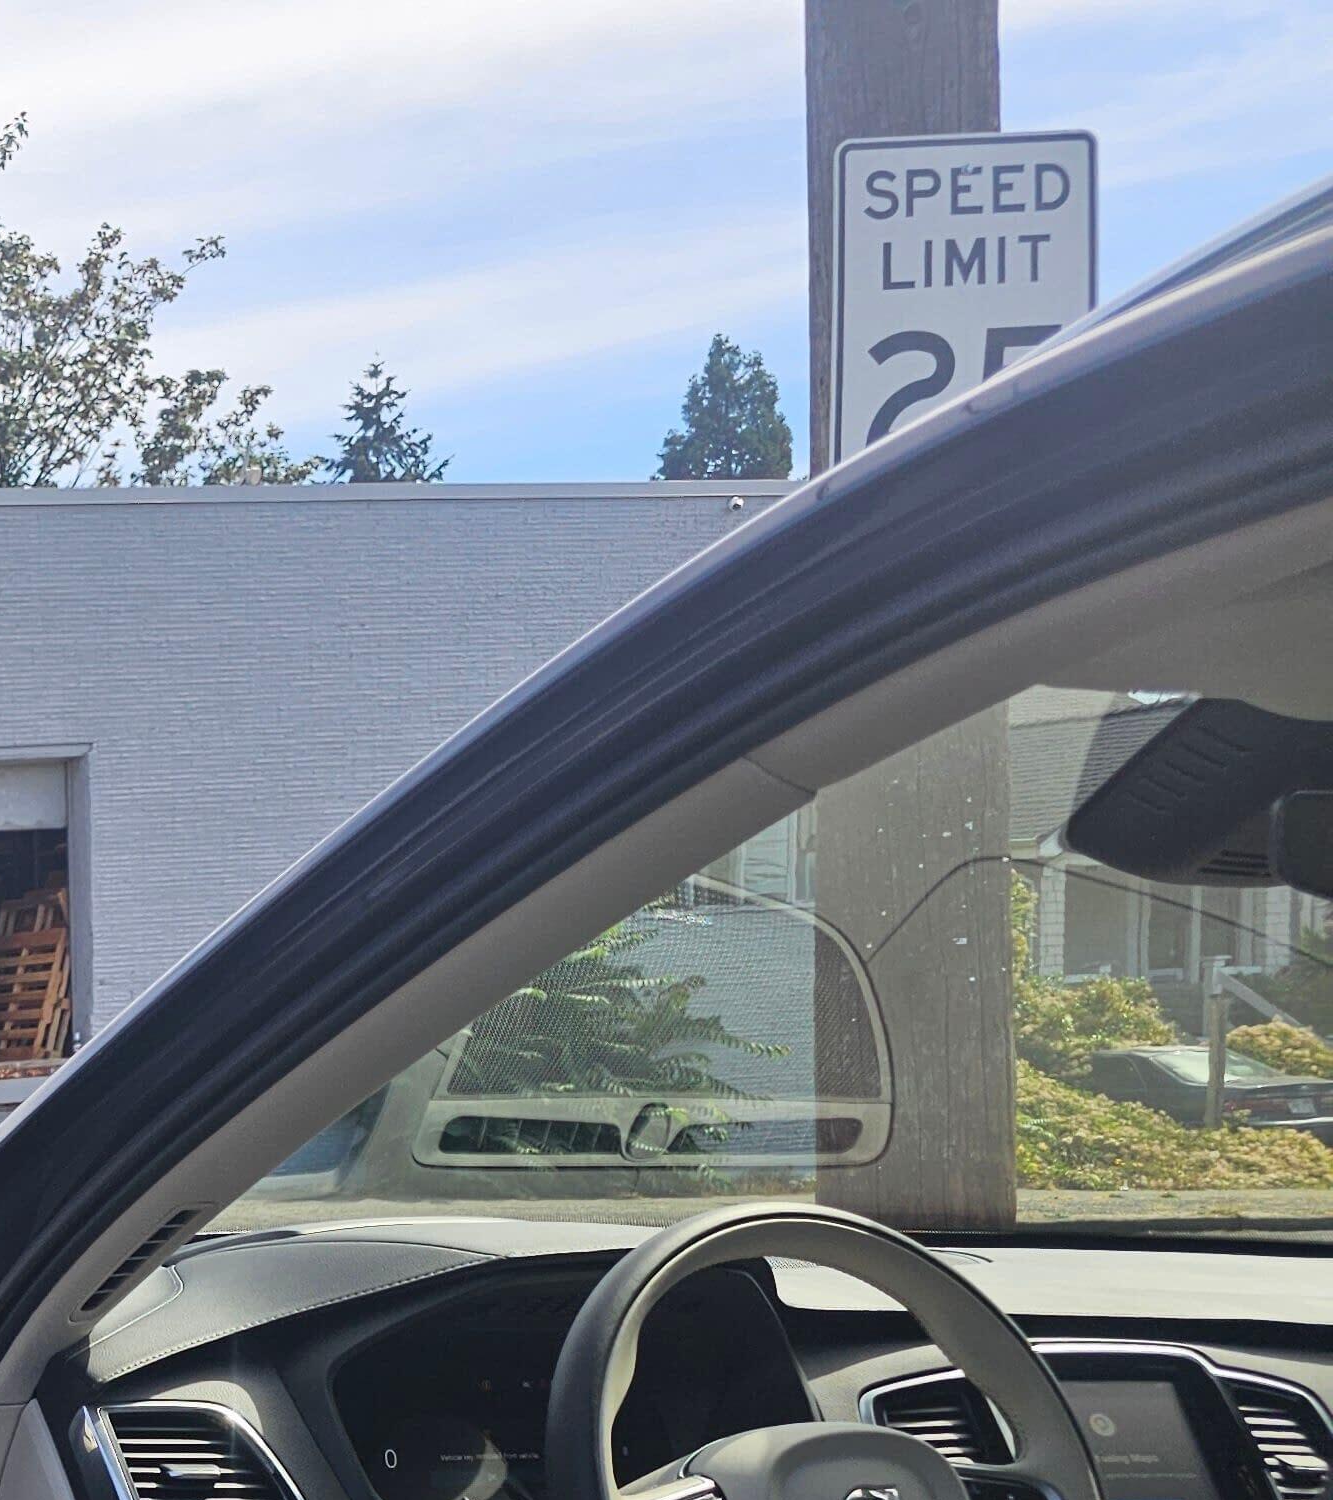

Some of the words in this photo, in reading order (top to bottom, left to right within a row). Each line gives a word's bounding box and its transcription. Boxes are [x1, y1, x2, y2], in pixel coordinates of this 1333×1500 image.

[863, 163, 1070, 219] SPEED
[883, 234, 1050, 290] LIMIT
[384, 1448, 398, 1469] 0
